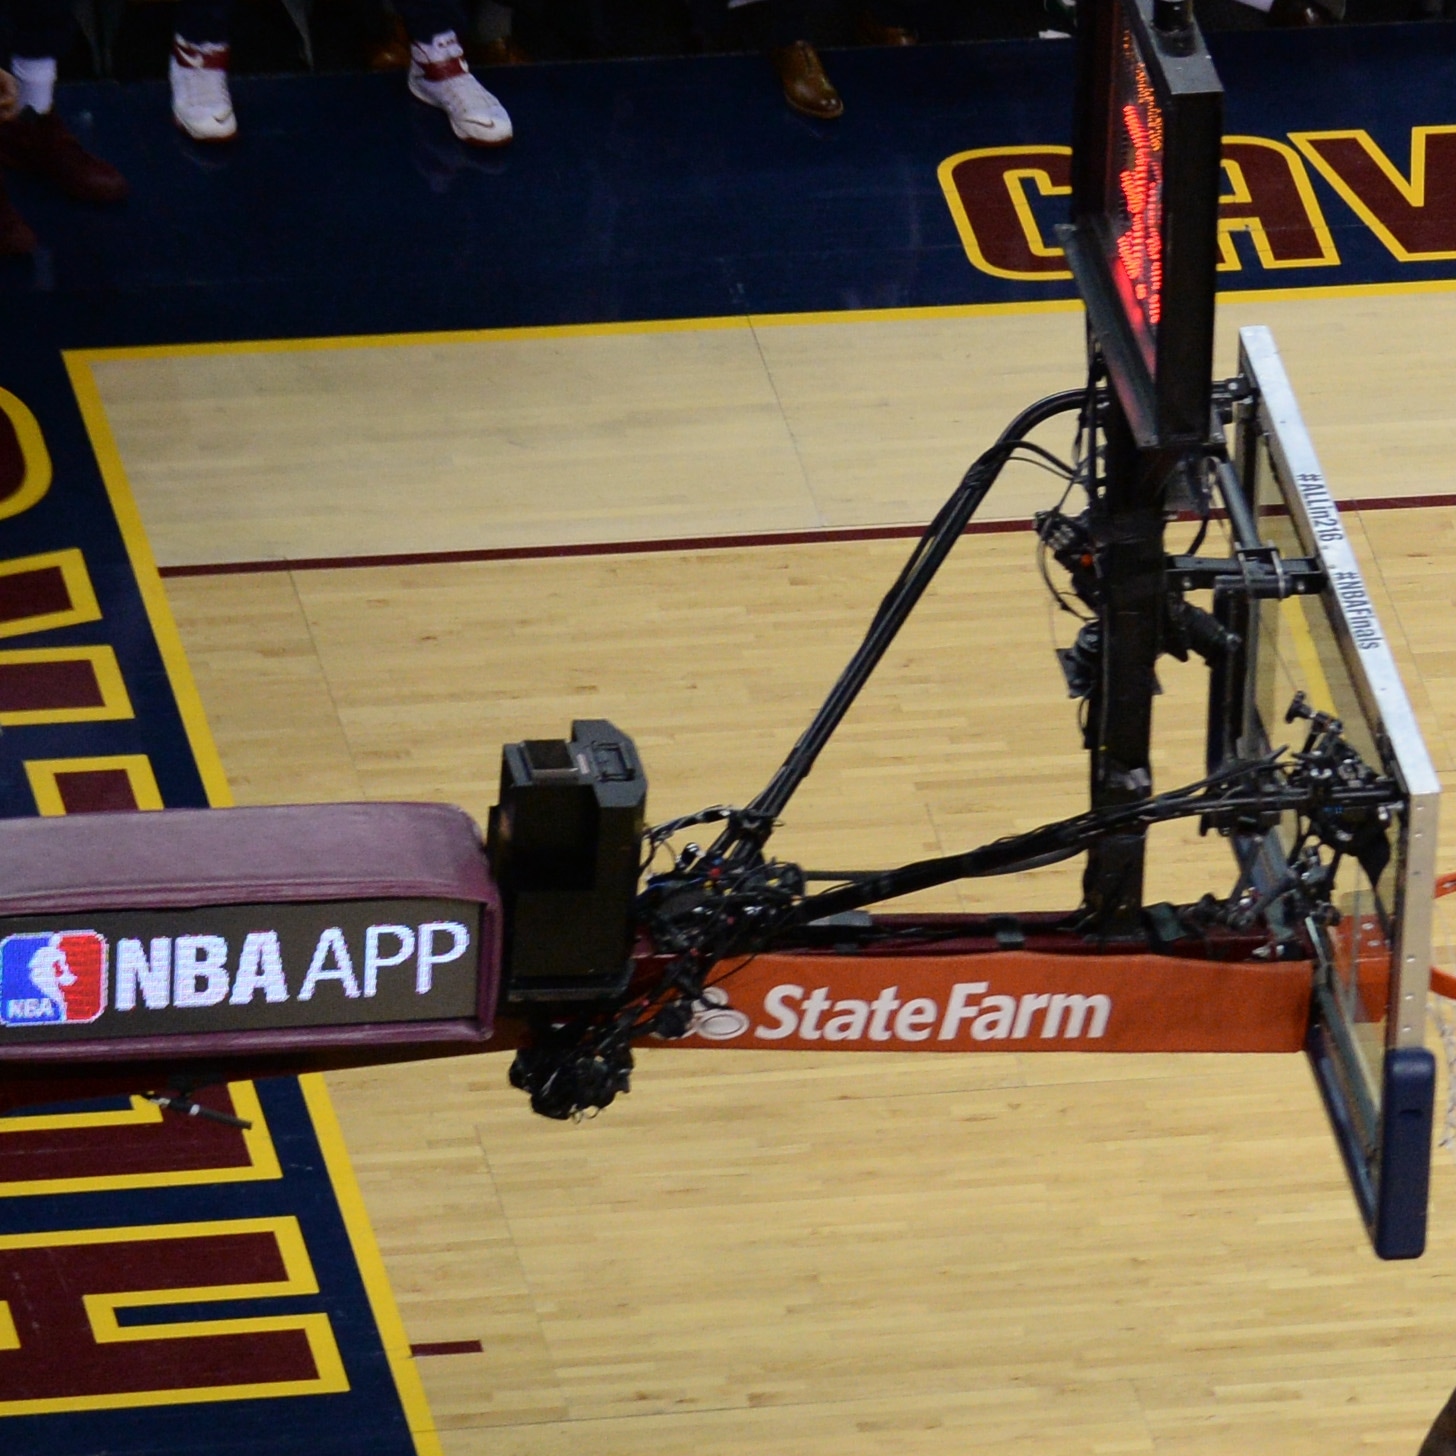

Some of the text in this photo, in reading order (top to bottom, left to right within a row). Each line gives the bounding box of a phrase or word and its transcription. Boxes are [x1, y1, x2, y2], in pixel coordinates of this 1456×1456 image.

[1297, 473, 1384, 650] #ALLin216 #NBAFinals
[8, 997, 55, 1019] NBA
[115, 920, 470, 1010] NBA APP
